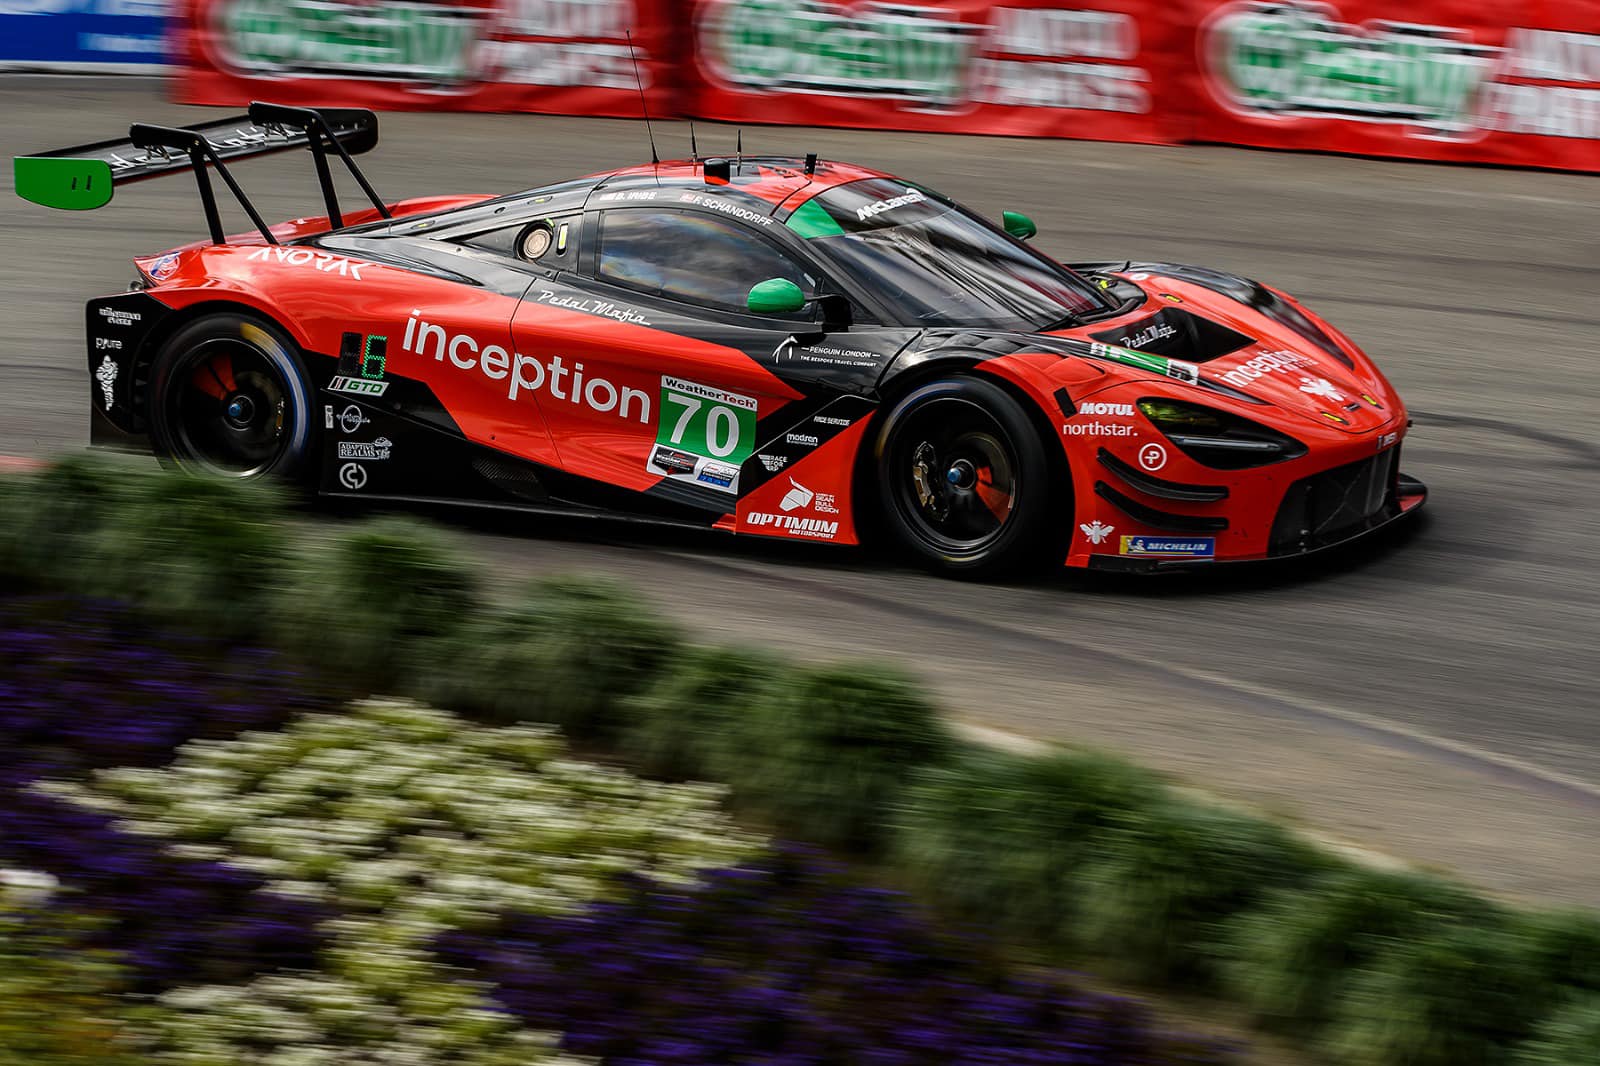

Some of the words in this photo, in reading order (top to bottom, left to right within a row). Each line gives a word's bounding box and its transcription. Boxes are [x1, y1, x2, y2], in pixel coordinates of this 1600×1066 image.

[702, 198, 774, 227] SCHANDORFF
[537, 290, 590, 312] Pedal
[591, 300, 652, 326] Mafia
[809, 346, 841, 356] PENGUIN
[841, 349, 872, 358] LONDON
[402, 309, 651, 424] inception
[347, 381, 384, 394] GTD
[665, 378, 755, 408] WeatherTech
[1080, 402, 1135, 416] MOTUL
[668, 392, 739, 457] 70
[1063, 421, 1138, 437] northstar.
[340, 449, 376, 457] REALMS
[341, 443, 375, 451] ADAPTIVE
[746, 511, 839, 534] OPTIMUM
[1146, 543, 1207, 551] MICHELIN
